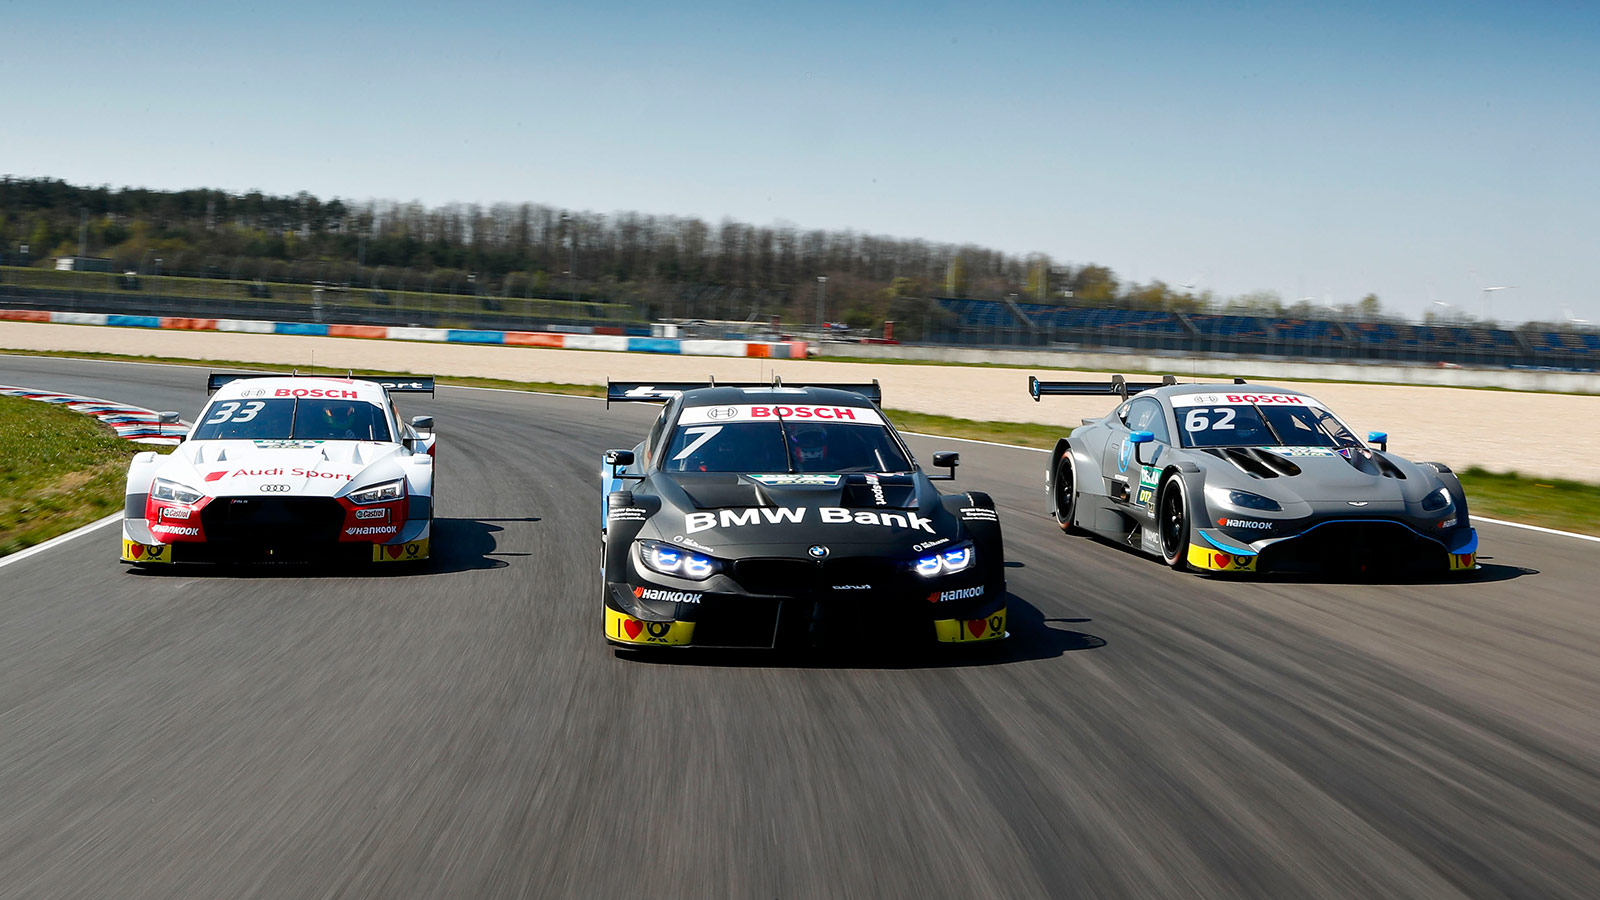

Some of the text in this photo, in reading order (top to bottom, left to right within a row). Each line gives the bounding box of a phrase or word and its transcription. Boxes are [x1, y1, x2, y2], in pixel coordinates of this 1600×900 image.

[274, 388, 358, 399] BOSCH
[1226, 394, 1303, 404] BOSCH
[206, 401, 266, 425] 33
[751, 406, 856, 420] BOSCH
[1185, 408, 1237, 432] 62
[672, 425, 724, 460] 7
[232, 468, 353, 481] Audi Sport
[685, 507, 936, 534] BMW Bank
